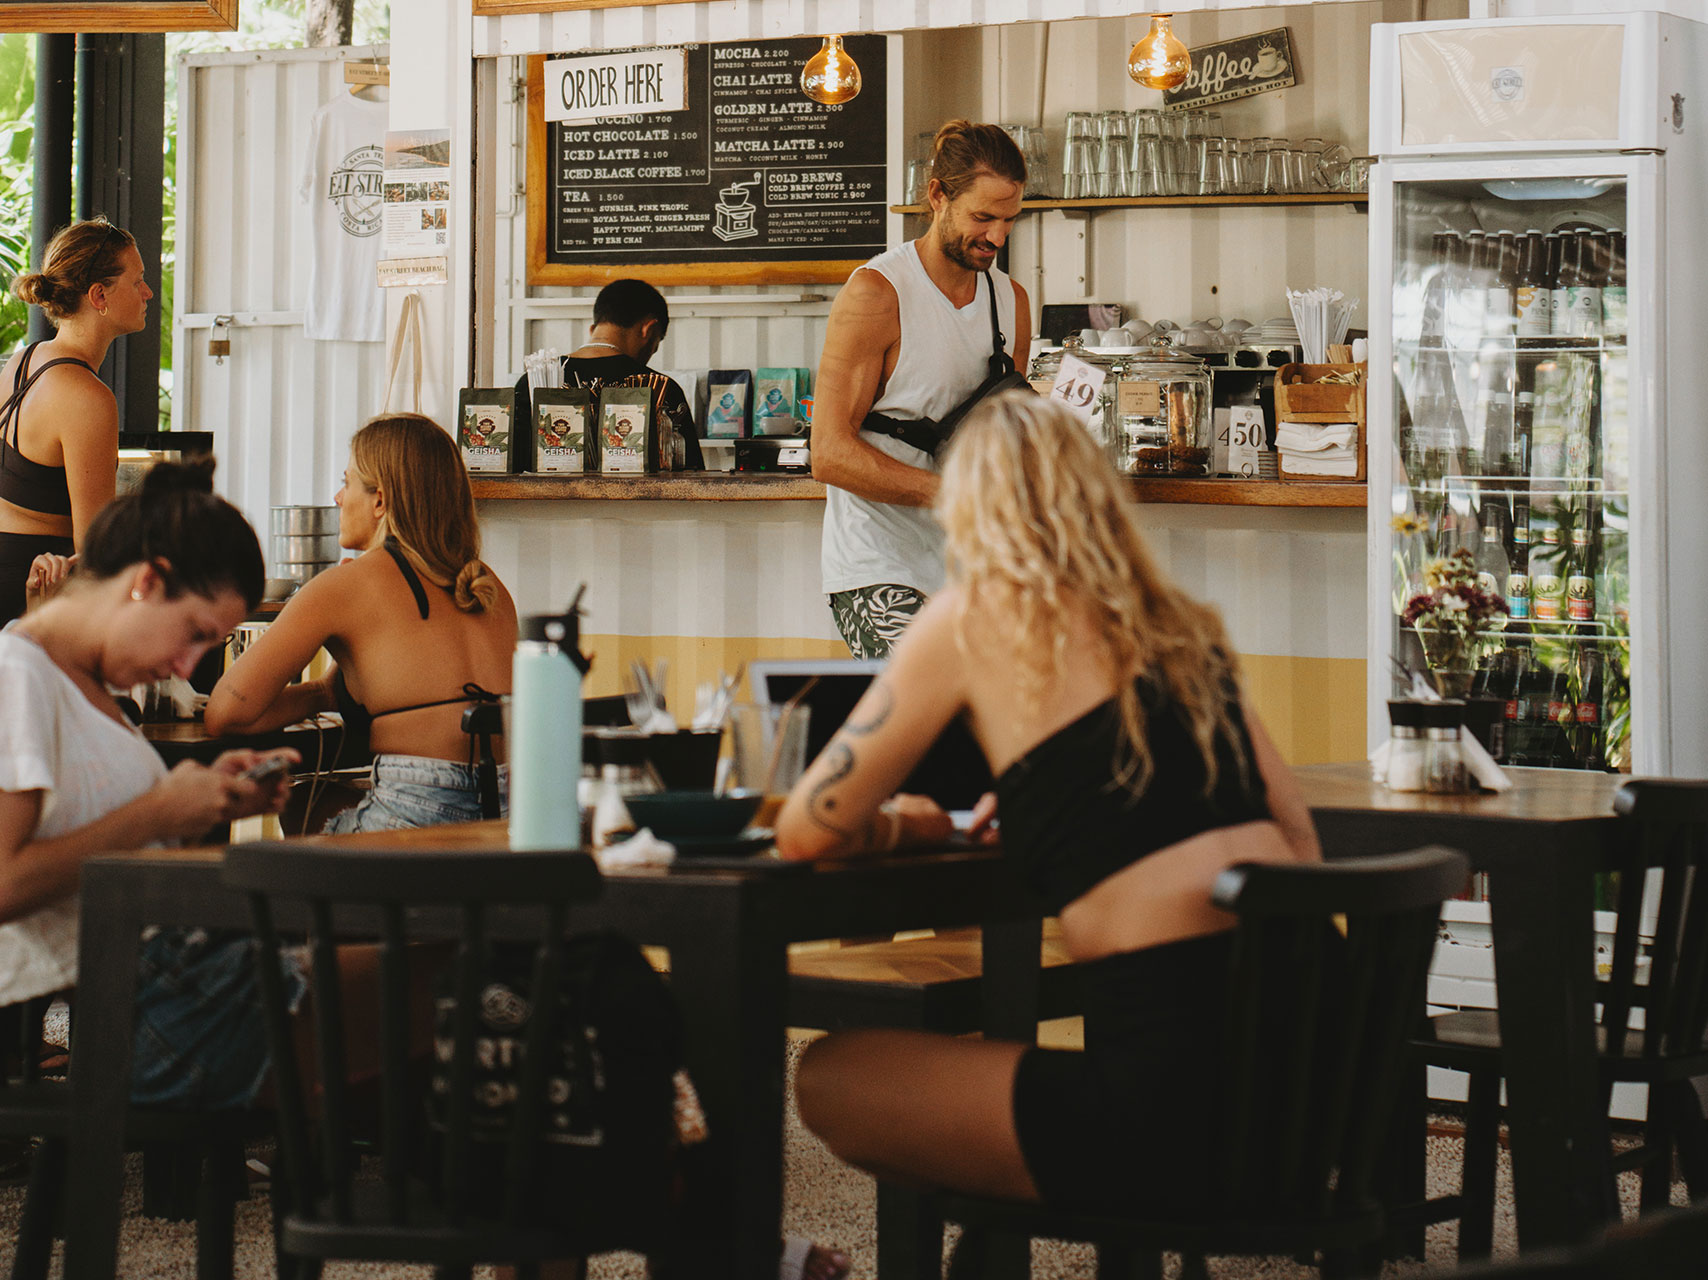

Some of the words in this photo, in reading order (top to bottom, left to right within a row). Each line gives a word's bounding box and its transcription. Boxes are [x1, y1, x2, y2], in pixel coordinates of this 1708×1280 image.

[715, 48, 761, 60] MOCHA
[764, 50, 789, 58] 2.200
[1169, 52, 1256, 95] offee
[713, 75, 746, 87] CHAI
[750, 73, 792, 85] LATTE
[561, 67, 618, 111] ORDER
[625, 63, 664, 105] HERE
[714, 103, 767, 115] GOLDEN
[770, 102, 812, 113] LATTE
[564, 132, 590, 142] HOT
[593, 130, 669, 141] CHOCOLATE
[674, 132, 697, 140] 1.500
[715, 141, 769, 152] MATCHA
[773, 139, 815, 151] LATTE
[564, 150, 595, 160] ICED
[598, 149, 640, 160] LATTE
[564, 169, 593, 179] ICED
[594, 168, 635, 178] BLACK
[638, 167, 682, 177] COFFEE
[769, 174, 798, 183] COLD
[802, 173, 842, 183] BREWS
[563, 192, 590, 202] TEA
[1056, 377, 1094, 407] 49
[608, 448, 638, 456] GEISHA
